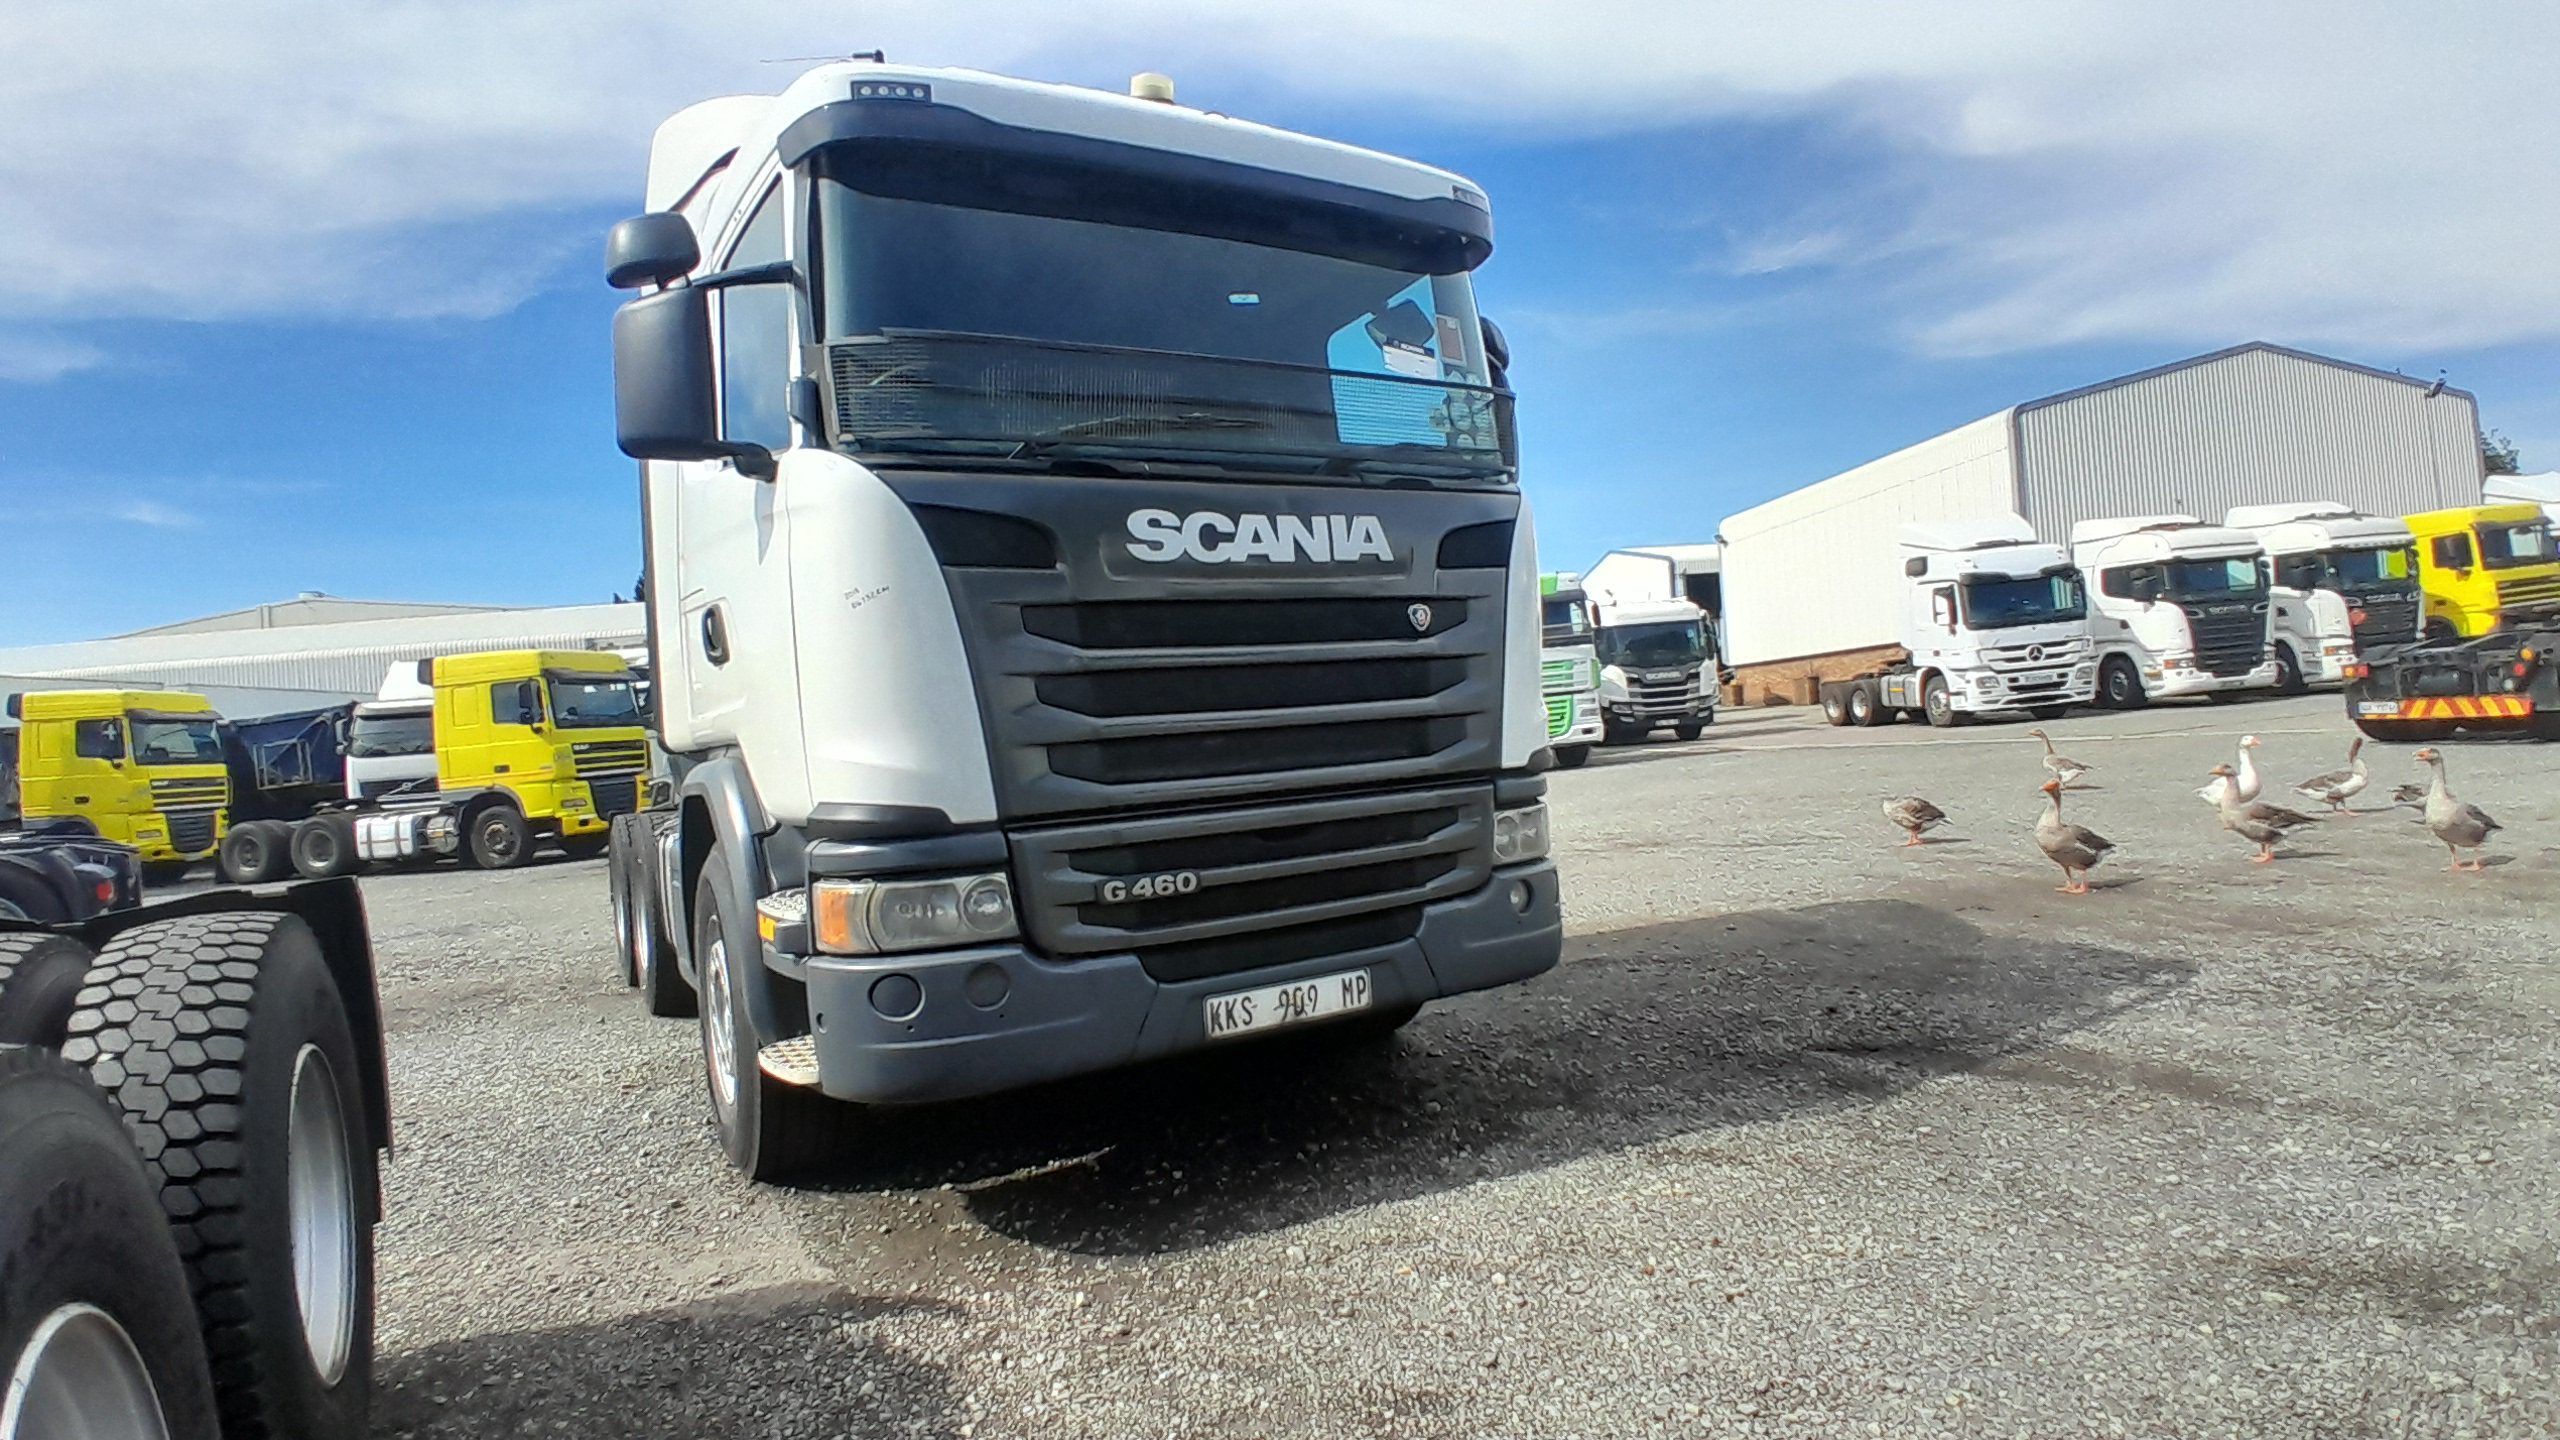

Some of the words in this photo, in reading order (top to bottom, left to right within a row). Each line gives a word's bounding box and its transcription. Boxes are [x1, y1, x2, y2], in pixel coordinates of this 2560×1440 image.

[1125, 508, 1395, 564] SCANIA
[1209, 996, 1254, 1033] KKS
[1341, 975, 1367, 1008] MP
